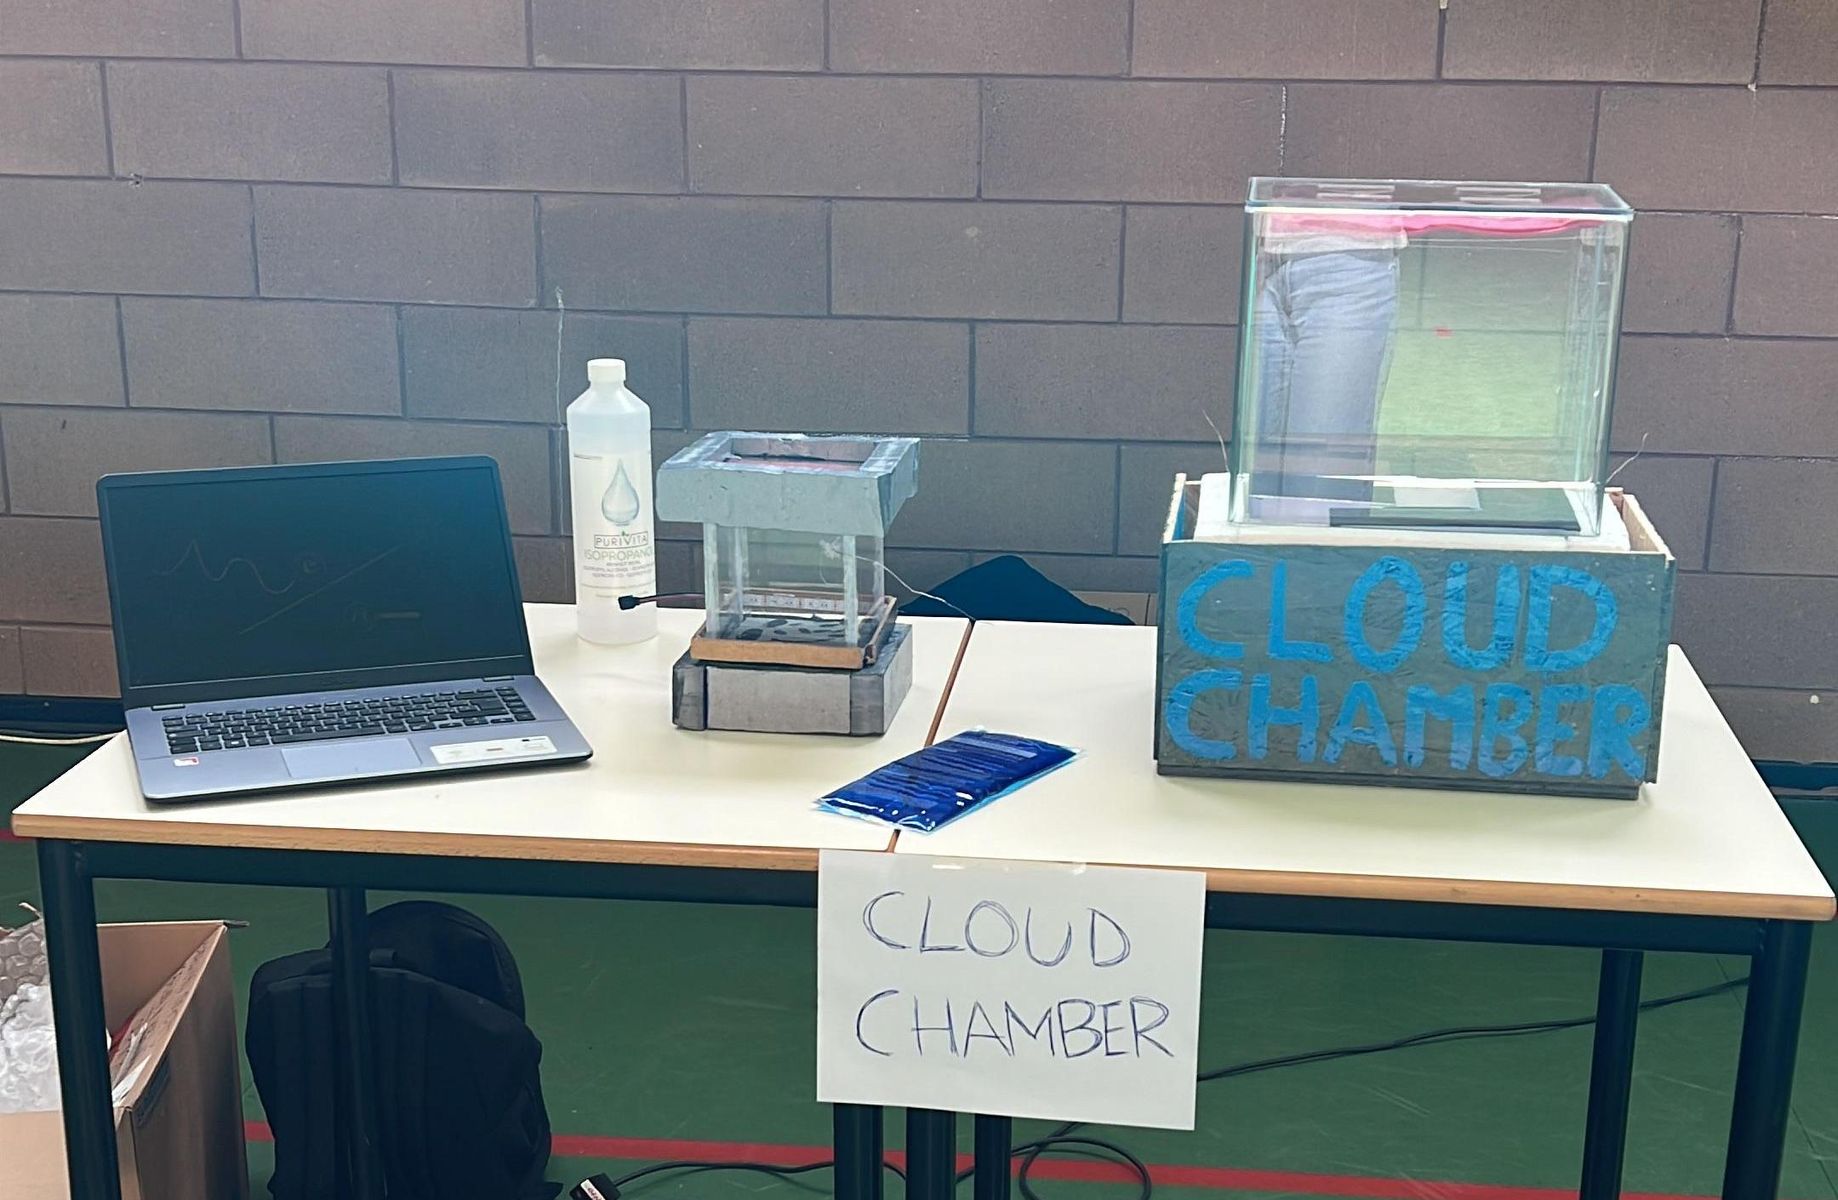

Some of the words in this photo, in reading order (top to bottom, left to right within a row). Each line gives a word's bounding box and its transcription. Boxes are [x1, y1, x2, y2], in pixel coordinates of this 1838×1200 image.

[583, 546, 653, 561] ISOPROPANO
[596, 535, 646, 546] PURIVITA
[1176, 555, 1620, 673] CLOUD
[1164, 668, 1652, 783] CHAMBER
[863, 891, 1130, 967] CLOUD
[856, 989, 1174, 1058] CHAMBER
